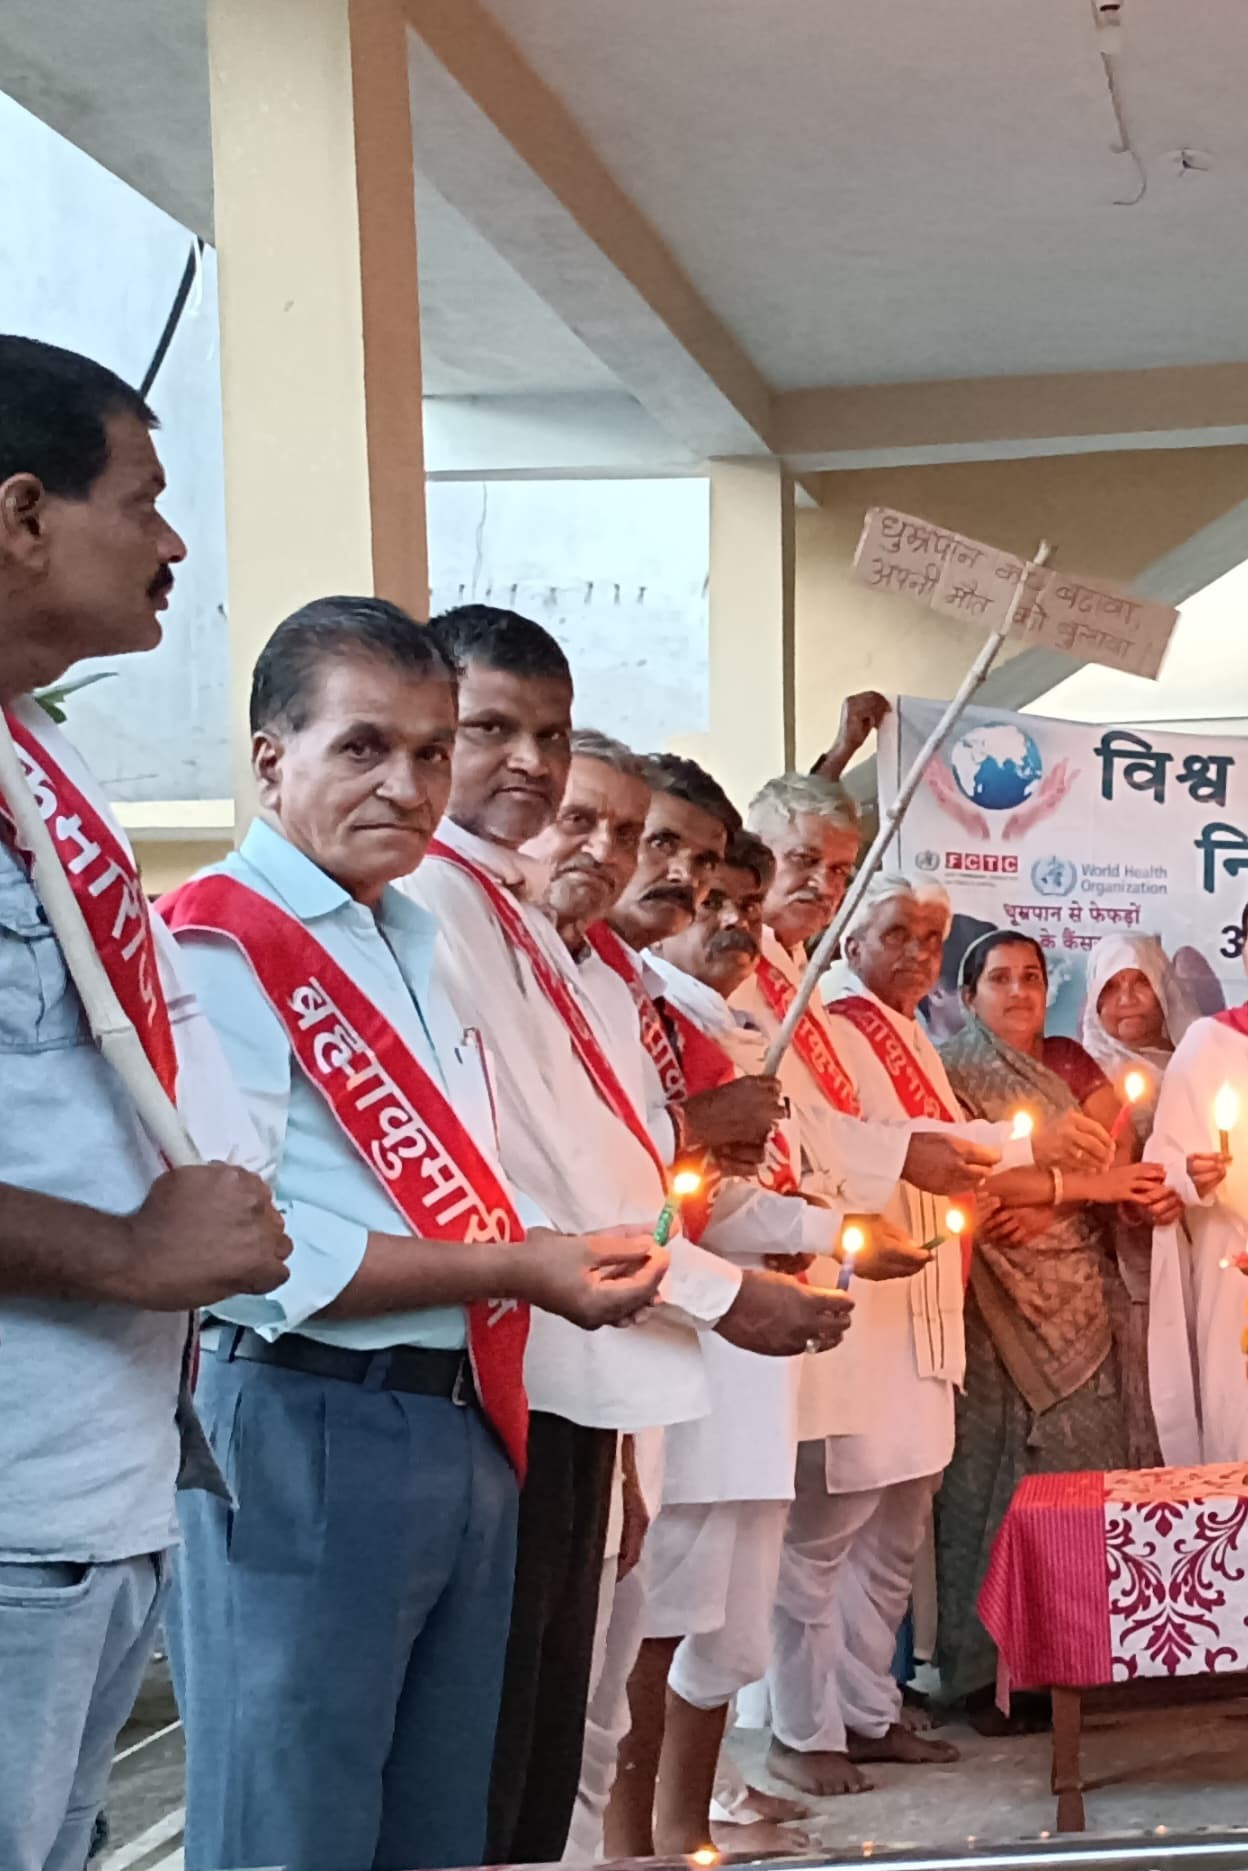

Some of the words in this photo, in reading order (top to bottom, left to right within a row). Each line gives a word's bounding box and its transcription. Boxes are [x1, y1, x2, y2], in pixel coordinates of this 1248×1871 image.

[1094, 729, 1236, 807] विश्व
[945, 852, 1019, 873] FCTC
[1080, 862, 1120, 877] World
[1124, 865, 1168, 879] Health
[1080, 880, 1168, 896] Organization
[1068, 900, 1084, 922] से
[1040, 927, 1057, 949] के
[1219, 925, 1245, 959] 3
